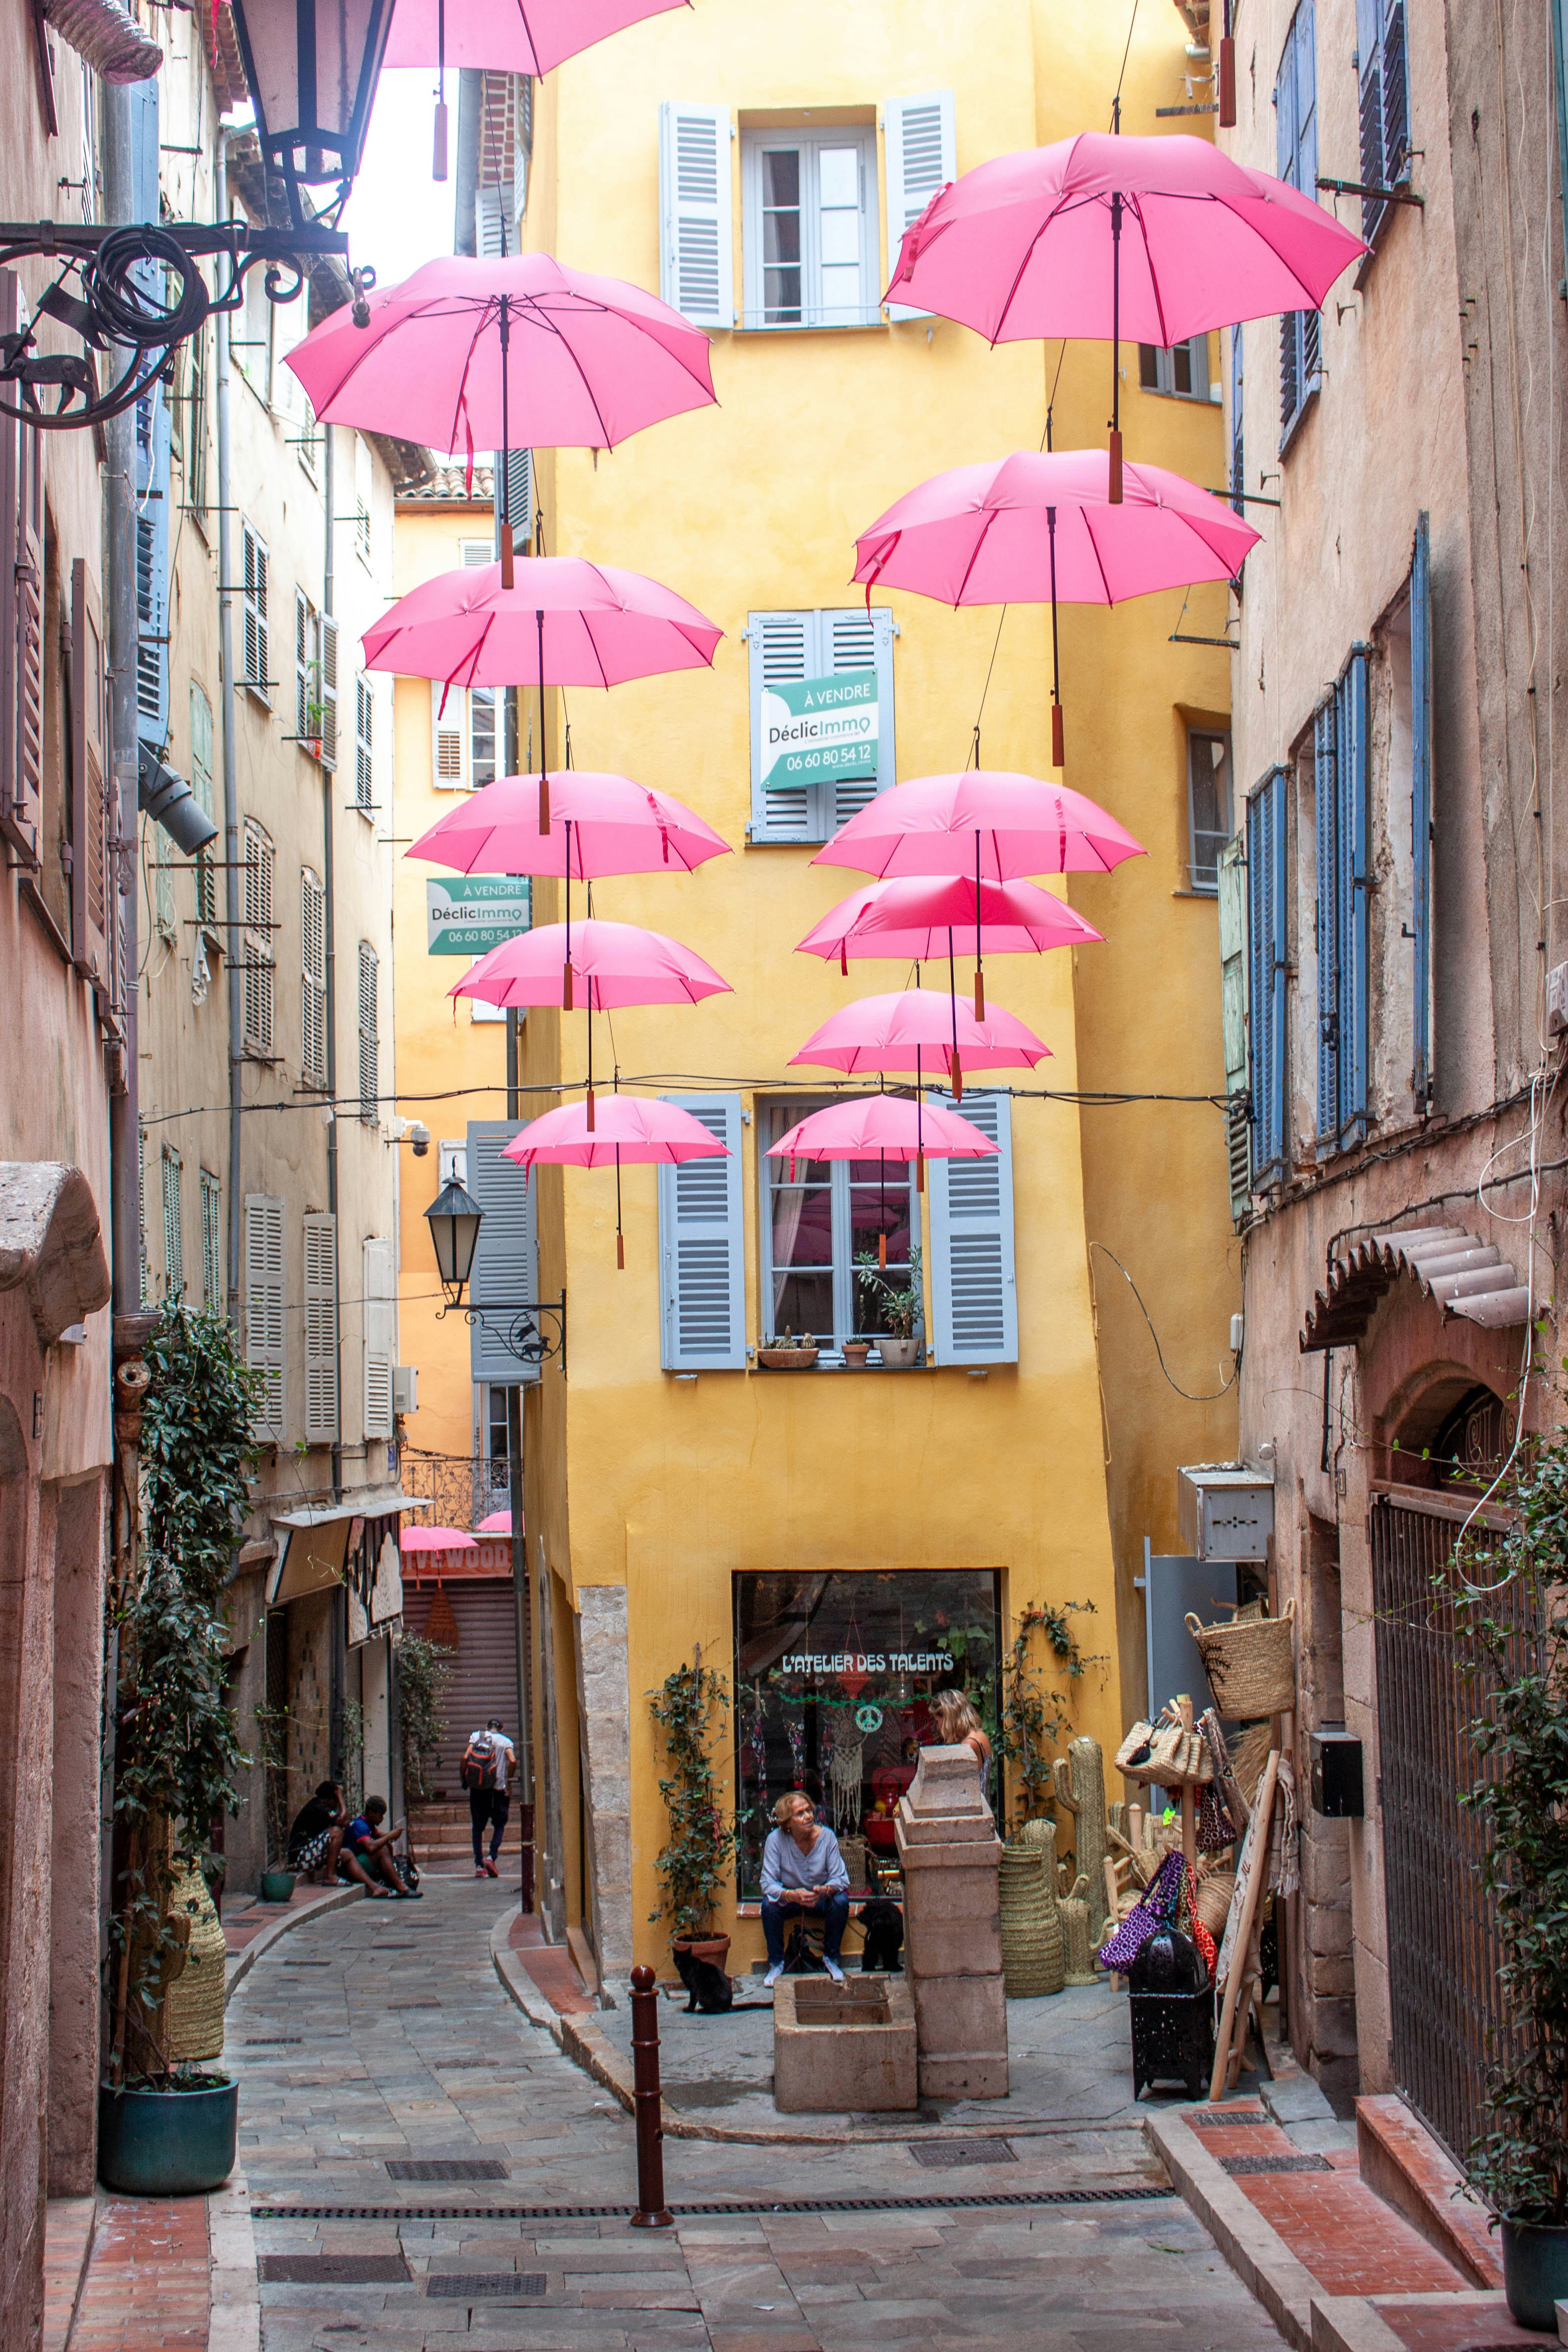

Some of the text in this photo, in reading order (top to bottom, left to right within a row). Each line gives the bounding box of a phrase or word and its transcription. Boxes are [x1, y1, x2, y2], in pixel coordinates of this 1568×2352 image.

[804, 683, 871, 708] À VENDRE
[787, 744, 871, 771] 06 60 80 54 12
[464, 884, 522, 896] À VENDRE
[449, 931, 462, 942] 06
[465, 931, 479, 942] 60
[481, 930, 494, 941] 80
[496, 929, 509, 940] 54
[783, 1652, 954, 1673] L'ATELIER DES TALENTS
